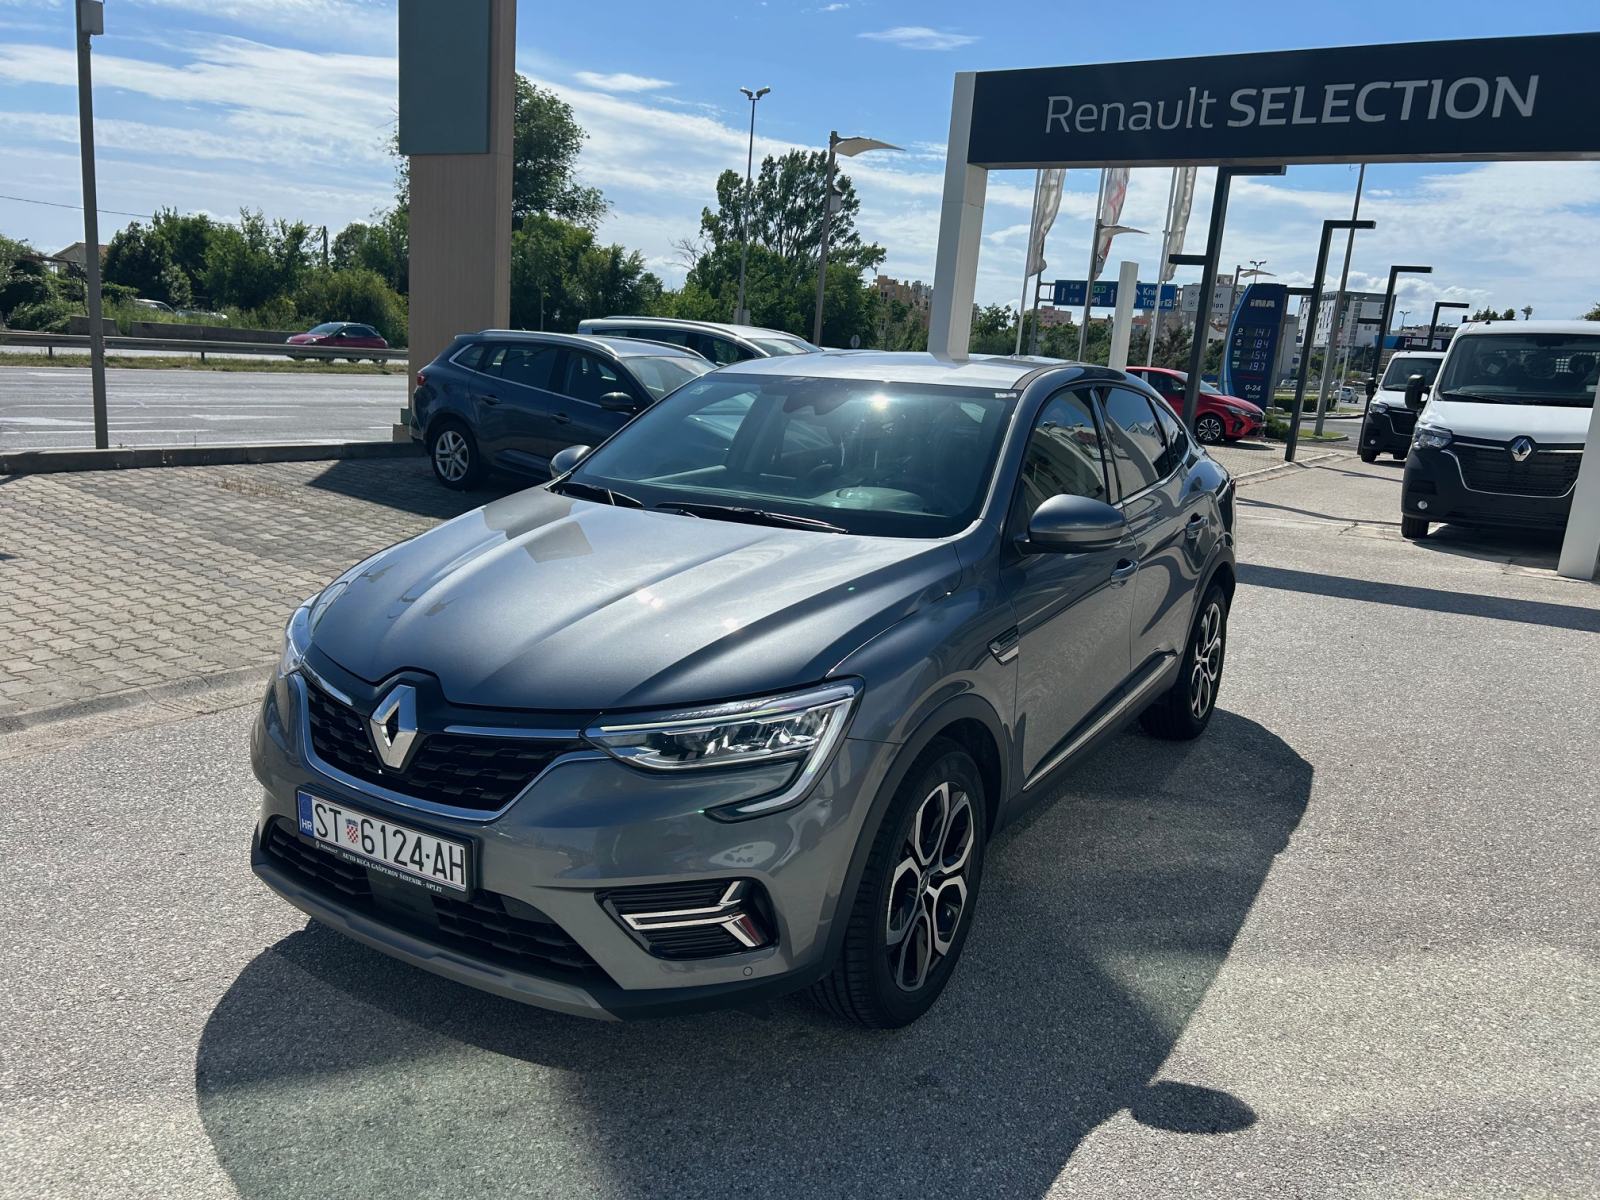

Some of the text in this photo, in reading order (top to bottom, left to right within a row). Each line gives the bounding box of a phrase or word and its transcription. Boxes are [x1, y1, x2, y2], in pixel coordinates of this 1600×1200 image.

[1045, 75, 1540, 134] Renault SELECTION
[301, 818, 313, 831] HR
[315, 804, 342, 843] ST
[425, 882, 443, 893] SPLIT
